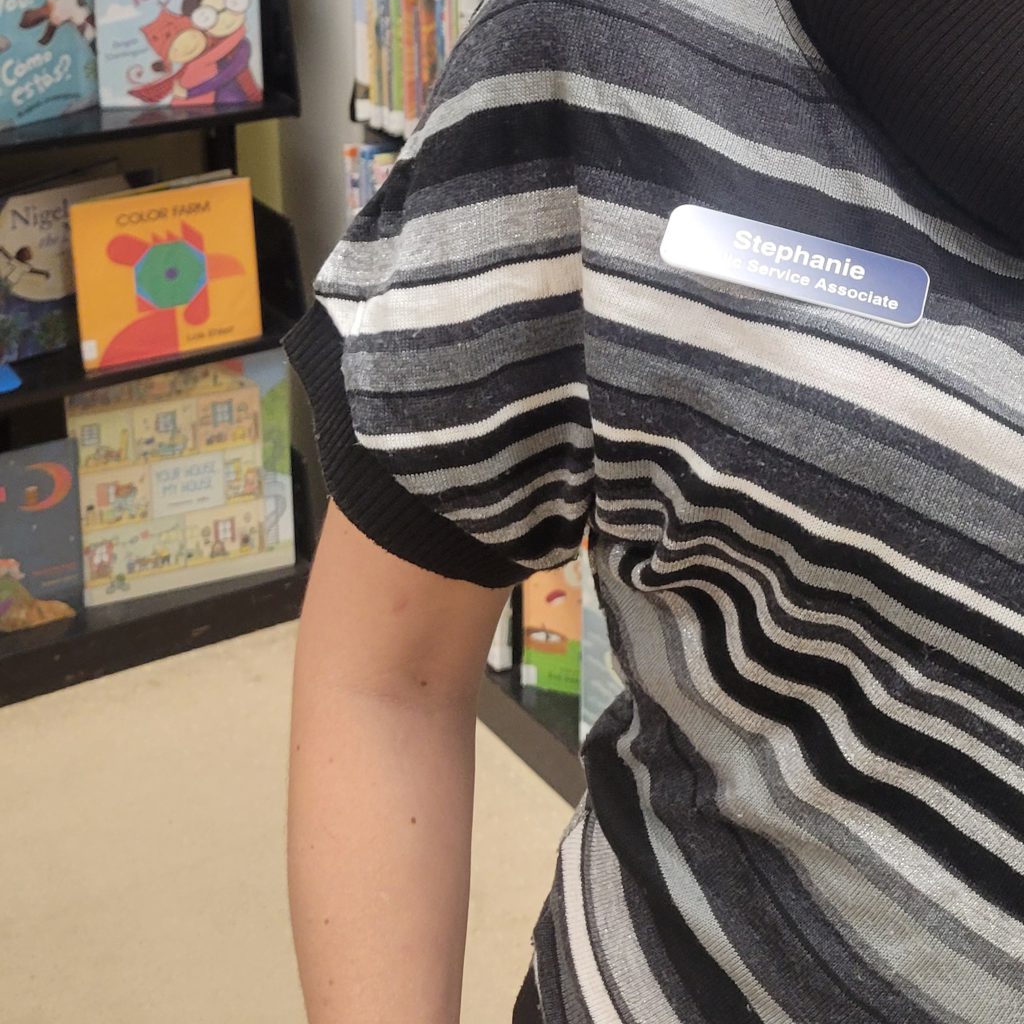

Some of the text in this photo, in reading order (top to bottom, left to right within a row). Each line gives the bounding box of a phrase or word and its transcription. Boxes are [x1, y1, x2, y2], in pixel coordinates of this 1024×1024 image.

[10, 197, 69, 230] Nigel
[116, 200, 211, 227] COLOR FARM
[733, 230, 866, 281] Stephanie
[747, 259, 811, 286] Service
[814, 277, 899, 311] Associate
